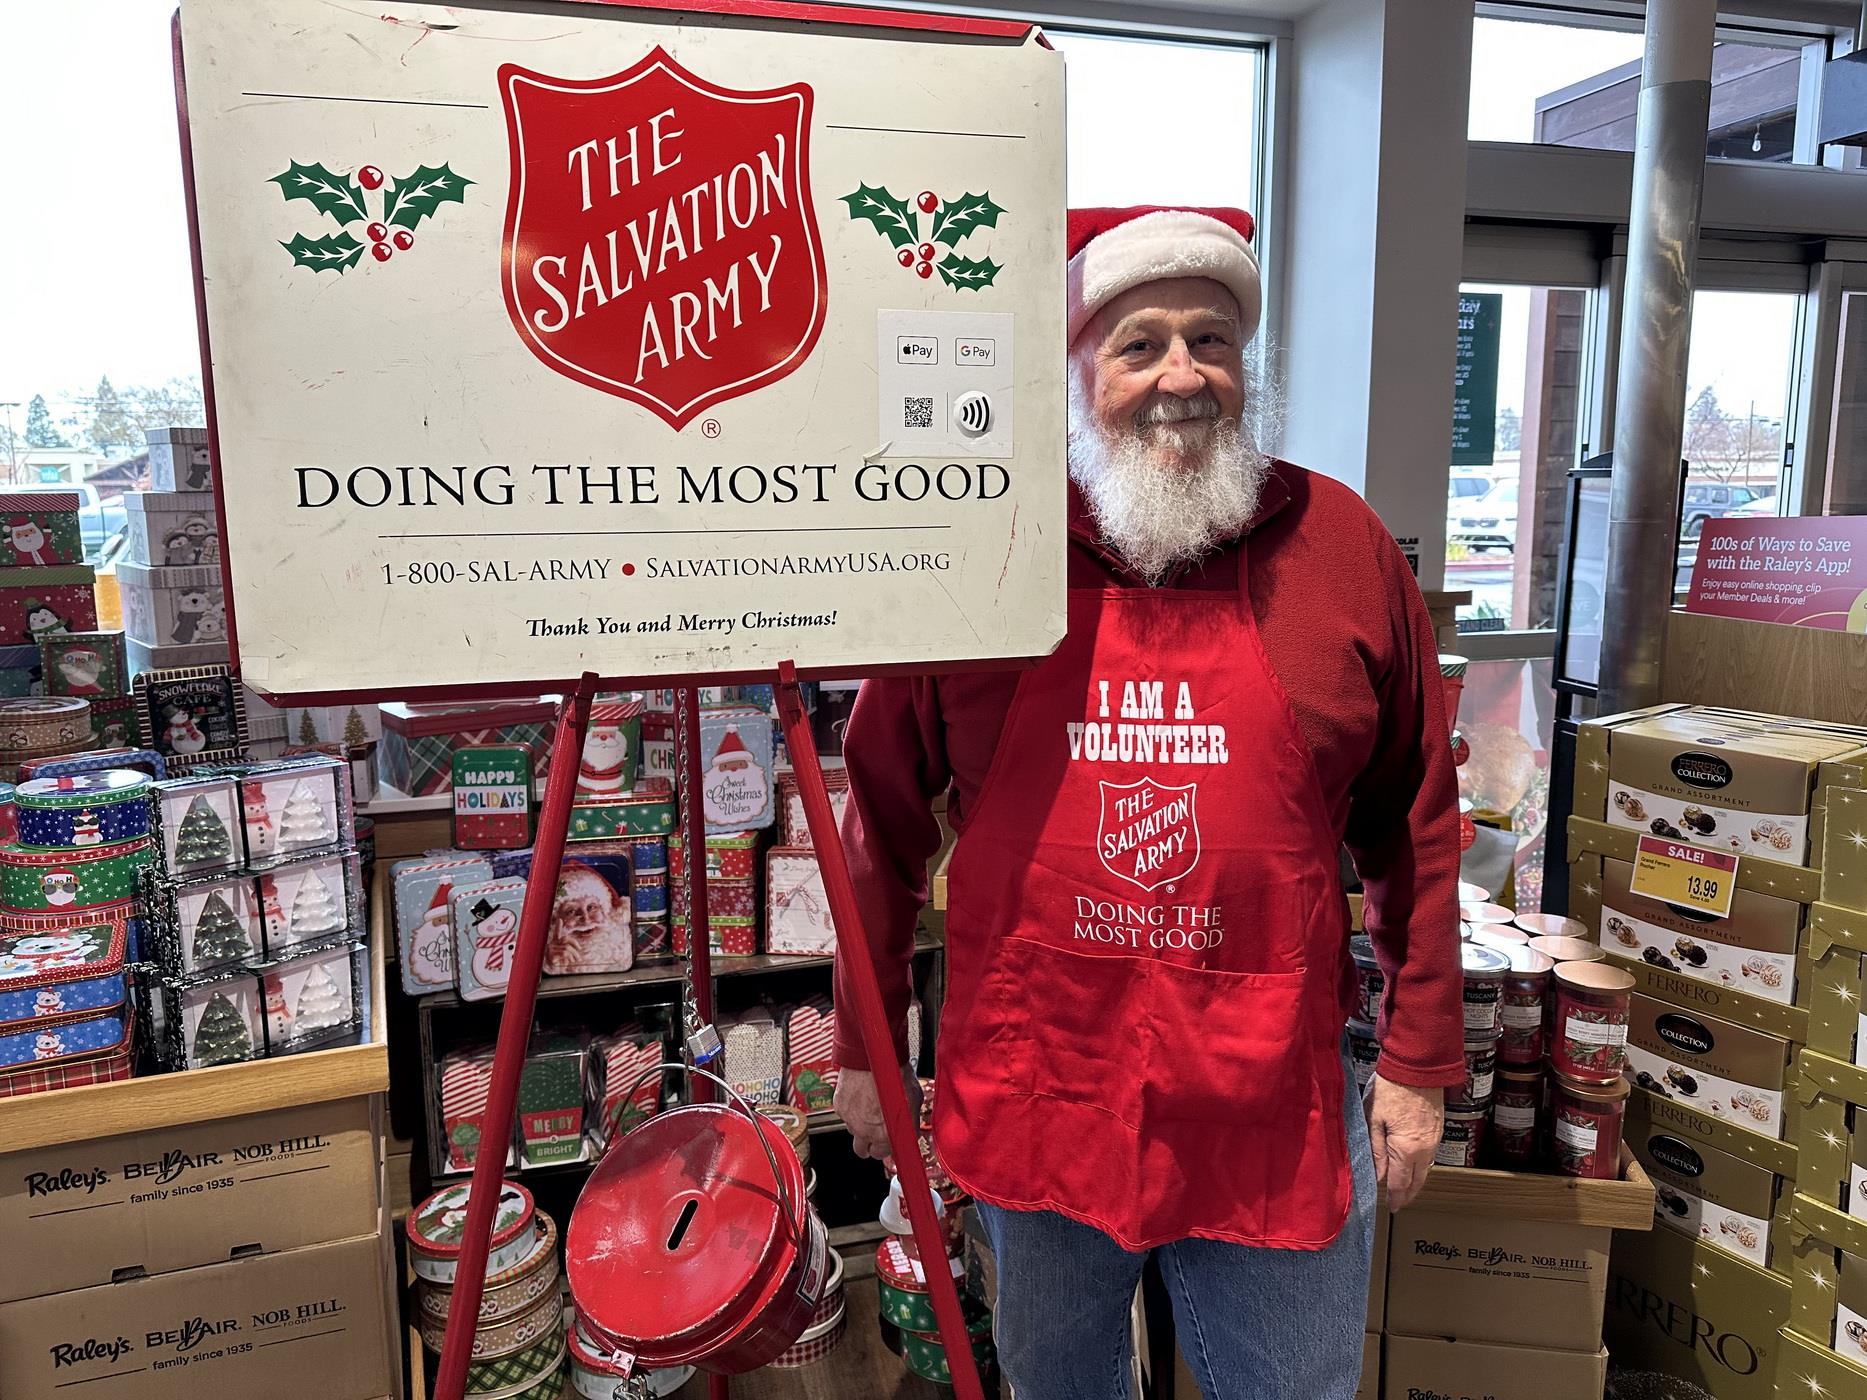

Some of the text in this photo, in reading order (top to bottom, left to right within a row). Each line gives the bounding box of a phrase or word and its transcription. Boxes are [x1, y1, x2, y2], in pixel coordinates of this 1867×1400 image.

[568, 107, 685, 212] THE
[532, 133, 787, 332] SALVATION
[633, 234, 782, 384] ARMY
[912, 344, 933, 359] Pay
[972, 346, 991, 359] Pay
[294, 463, 1011, 508] DOING THE MOST GOOD
[1710, 536, 1851, 554] 100s of Ways to Save
[381, 558, 612, 585] 1-800-SAL-ARMY
[1706, 555, 1851, 576] with the Raley's App!
[1702, 578, 1722, 590] Enjoy
[1722, 581, 1740, 591] easy
[1740, 580, 1764, 590] online
[1805, 582, 1822, 593] clip
[1700, 591, 1806, 605] your Member Deals & more!
[526, 609, 838, 637] Thank You and Merry Christmas!
[159, 682, 224, 701] SNOWFLAKE
[1098, 680, 1194, 720] I AM A
[1066, 721, 1229, 764] VOLUNTEER
[464, 770, 515, 785] HAPPY
[1677, 768, 1726, 783] COLLECTION
[1679, 758, 1727, 775] FERRERO
[457, 791, 525, 809] HOLIDAYS
[706, 784, 763, 804] Christmas
[1115, 787, 1154, 823] THE
[1651, 783, 1751, 807] GRAND ASSORTMENT
[719, 802, 751, 816] Wishes
[1104, 792, 1189, 859] SALVATION
[1133, 826, 1188, 878] ARMY
[1667, 845, 1705, 864] SALE!
[1687, 875, 1718, 899] 13.99
[1075, 895, 1222, 927] DOING THE
[1073, 920, 1223, 950] MOST GOOD
[1645, 912, 1743, 943] GRAND ASSORTMENT
[1648, 971, 1720, 1006] FERRERO
[1660, 1028, 1708, 1050] COLLECTION
[1638, 1039, 1731, 1076] GRAND ASSORTMENT
[1643, 1097, 1713, 1136] FERRERO
[233, 1143, 273, 1161] NOB
[265, 1152, 295, 1162] FOODS
[536, 1144, 573, 1157] BRIGHT
[1652, 1148, 1698, 1174] COLLECTION
[130, 1177, 234, 1205] family since 1935
[1468, 1266, 1530, 1279] family since 1935
[1531, 1255, 1557, 1267] NOB
[251, 1308, 291, 1328] NOB
[283, 1316, 313, 1328] FOODS
[1616, 1276, 1758, 1375] RRERO
[152, 1343, 253, 1371] family since 1935
